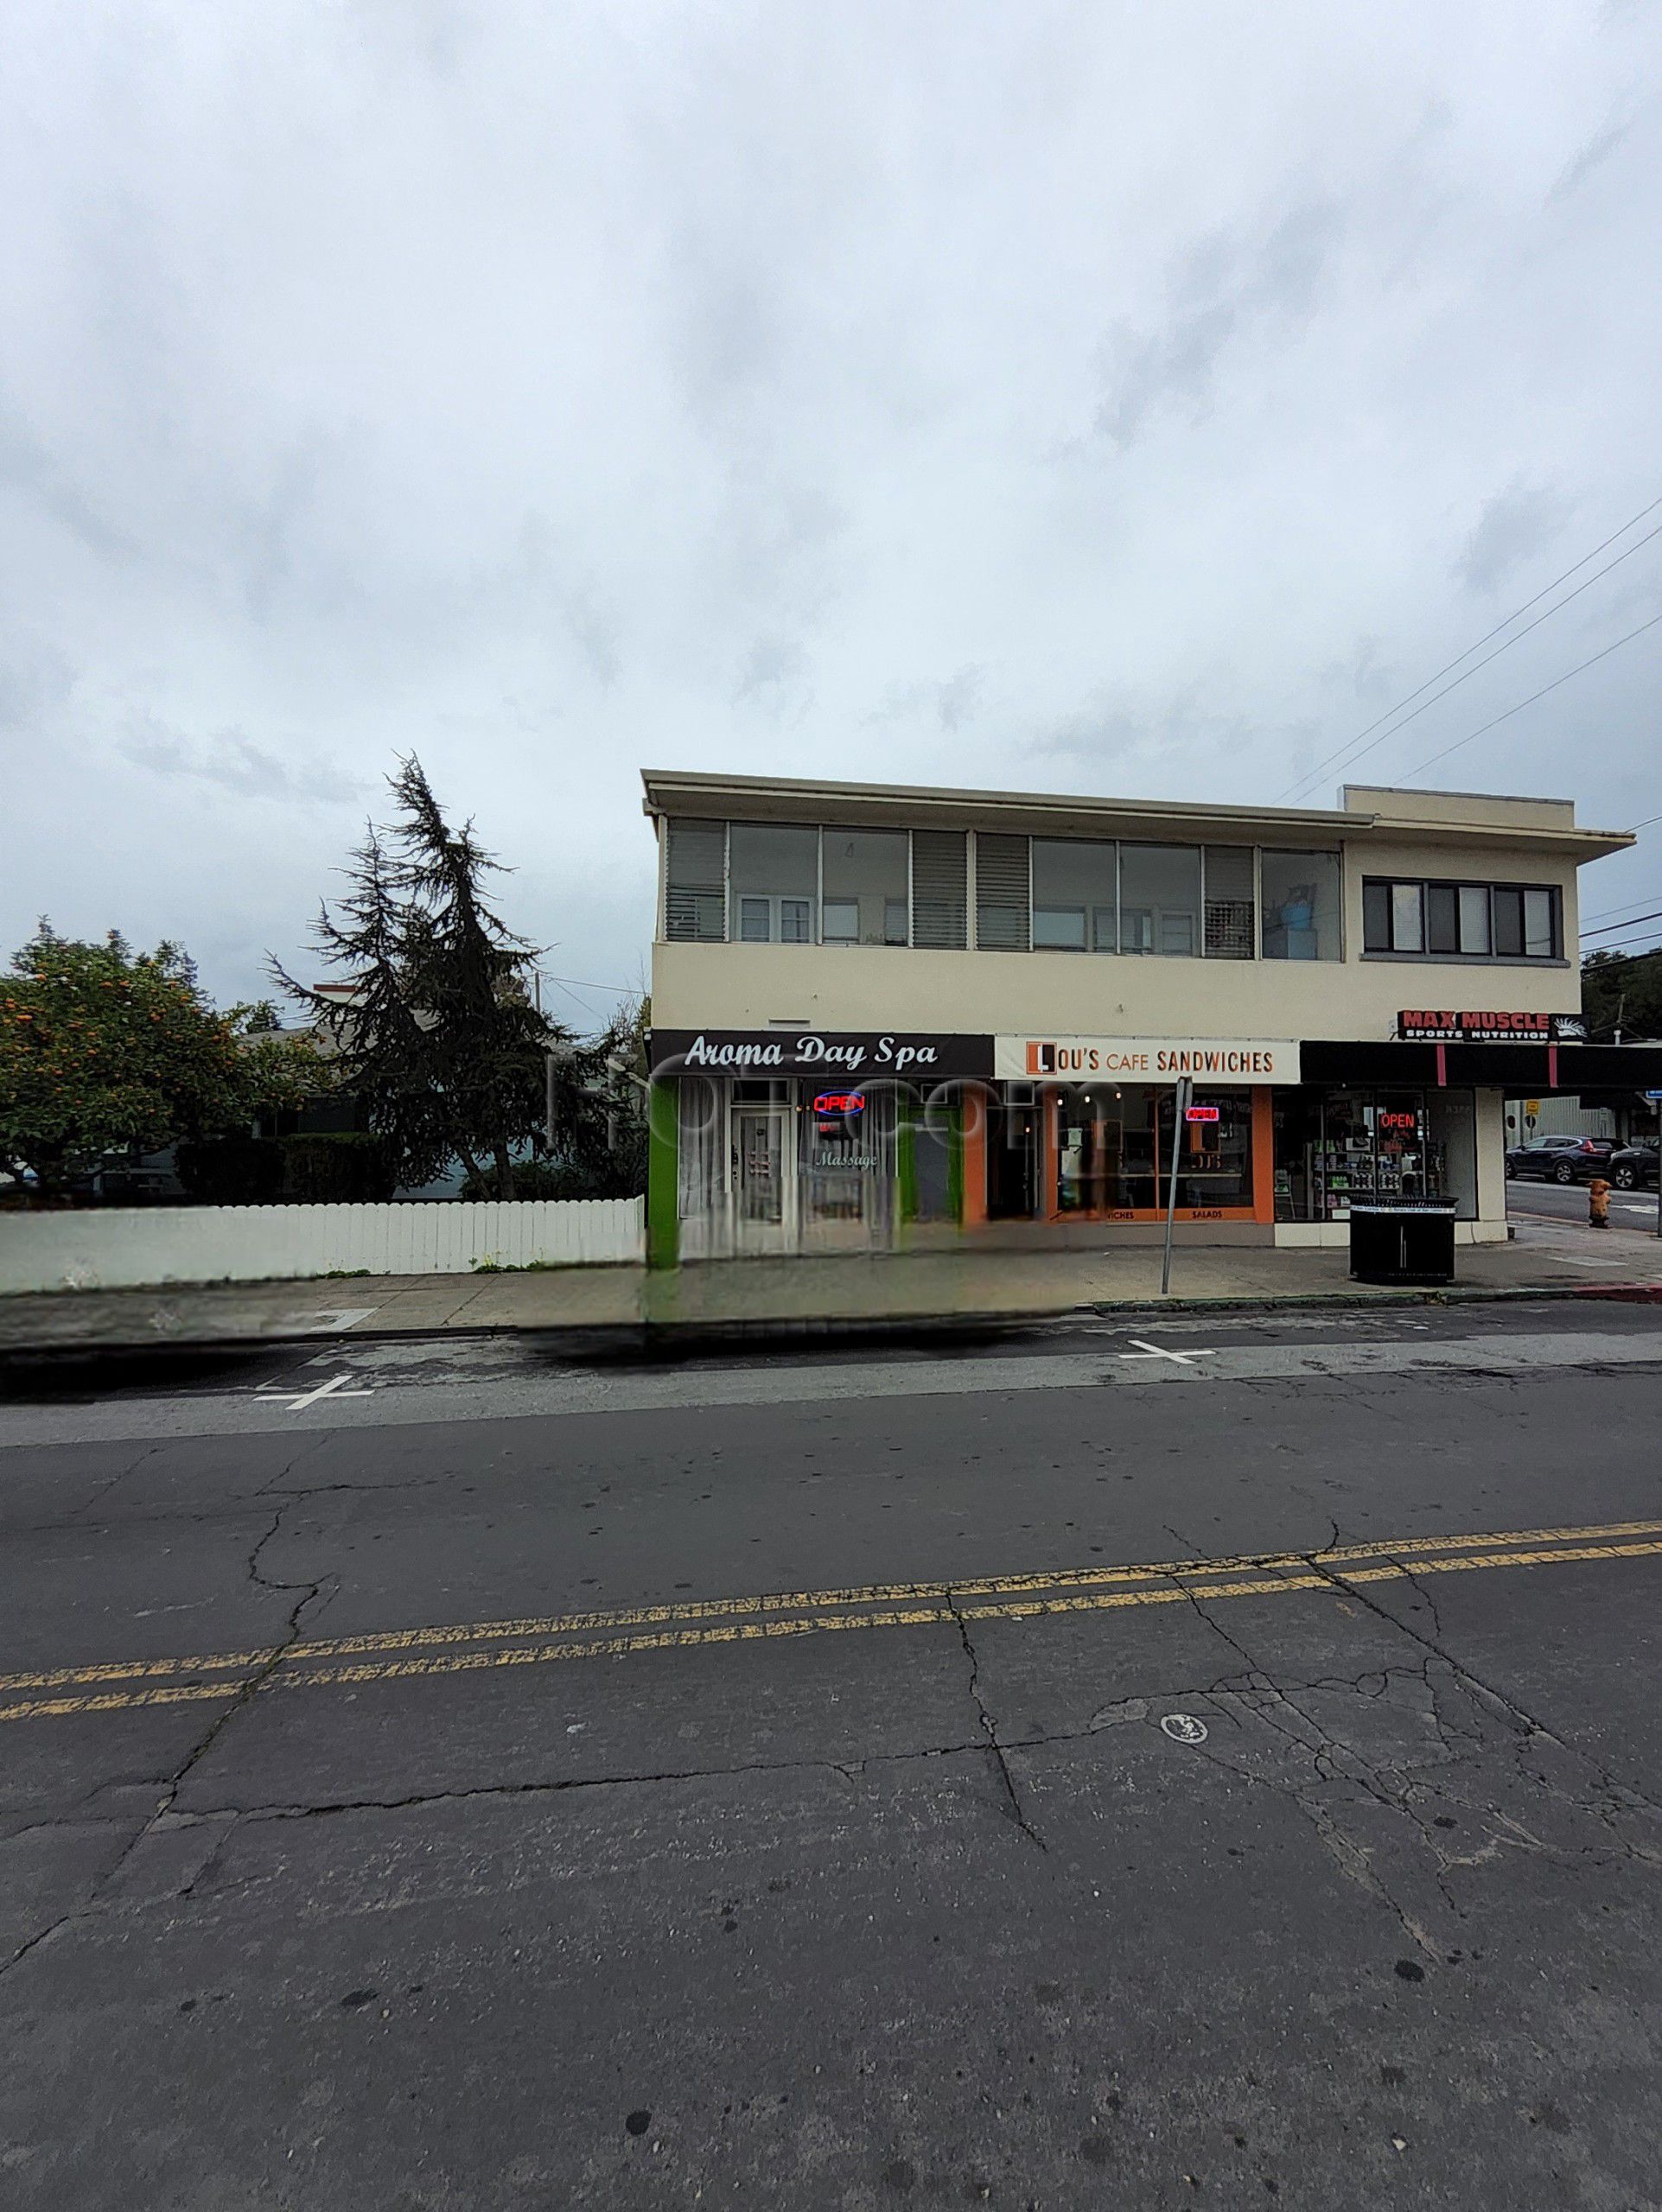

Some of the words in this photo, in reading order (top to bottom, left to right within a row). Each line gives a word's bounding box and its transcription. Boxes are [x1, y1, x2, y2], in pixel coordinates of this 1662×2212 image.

[1404, 1010, 1455, 1028] MAX
[1461, 1012, 1550, 1030] MUSCLE
[1406, 1029, 1463, 1038] SPORTS
[1471, 1030, 1549, 1039] NUTRITION
[685, 1035, 783, 1065] Aroma
[794, 1036, 867, 1071] Day
[874, 1037, 938, 1071] Spa
[1106, 1052, 1149, 1071] CAFE
[1156, 1050, 1273, 1073] SANDWICHES
[813, 1095, 865, 1112] OPEN
[1381, 1113, 1415, 1128] OPEN
[815, 1150, 878, 1168] Massage
[1192, 1210, 1222, 1219] SALADS
